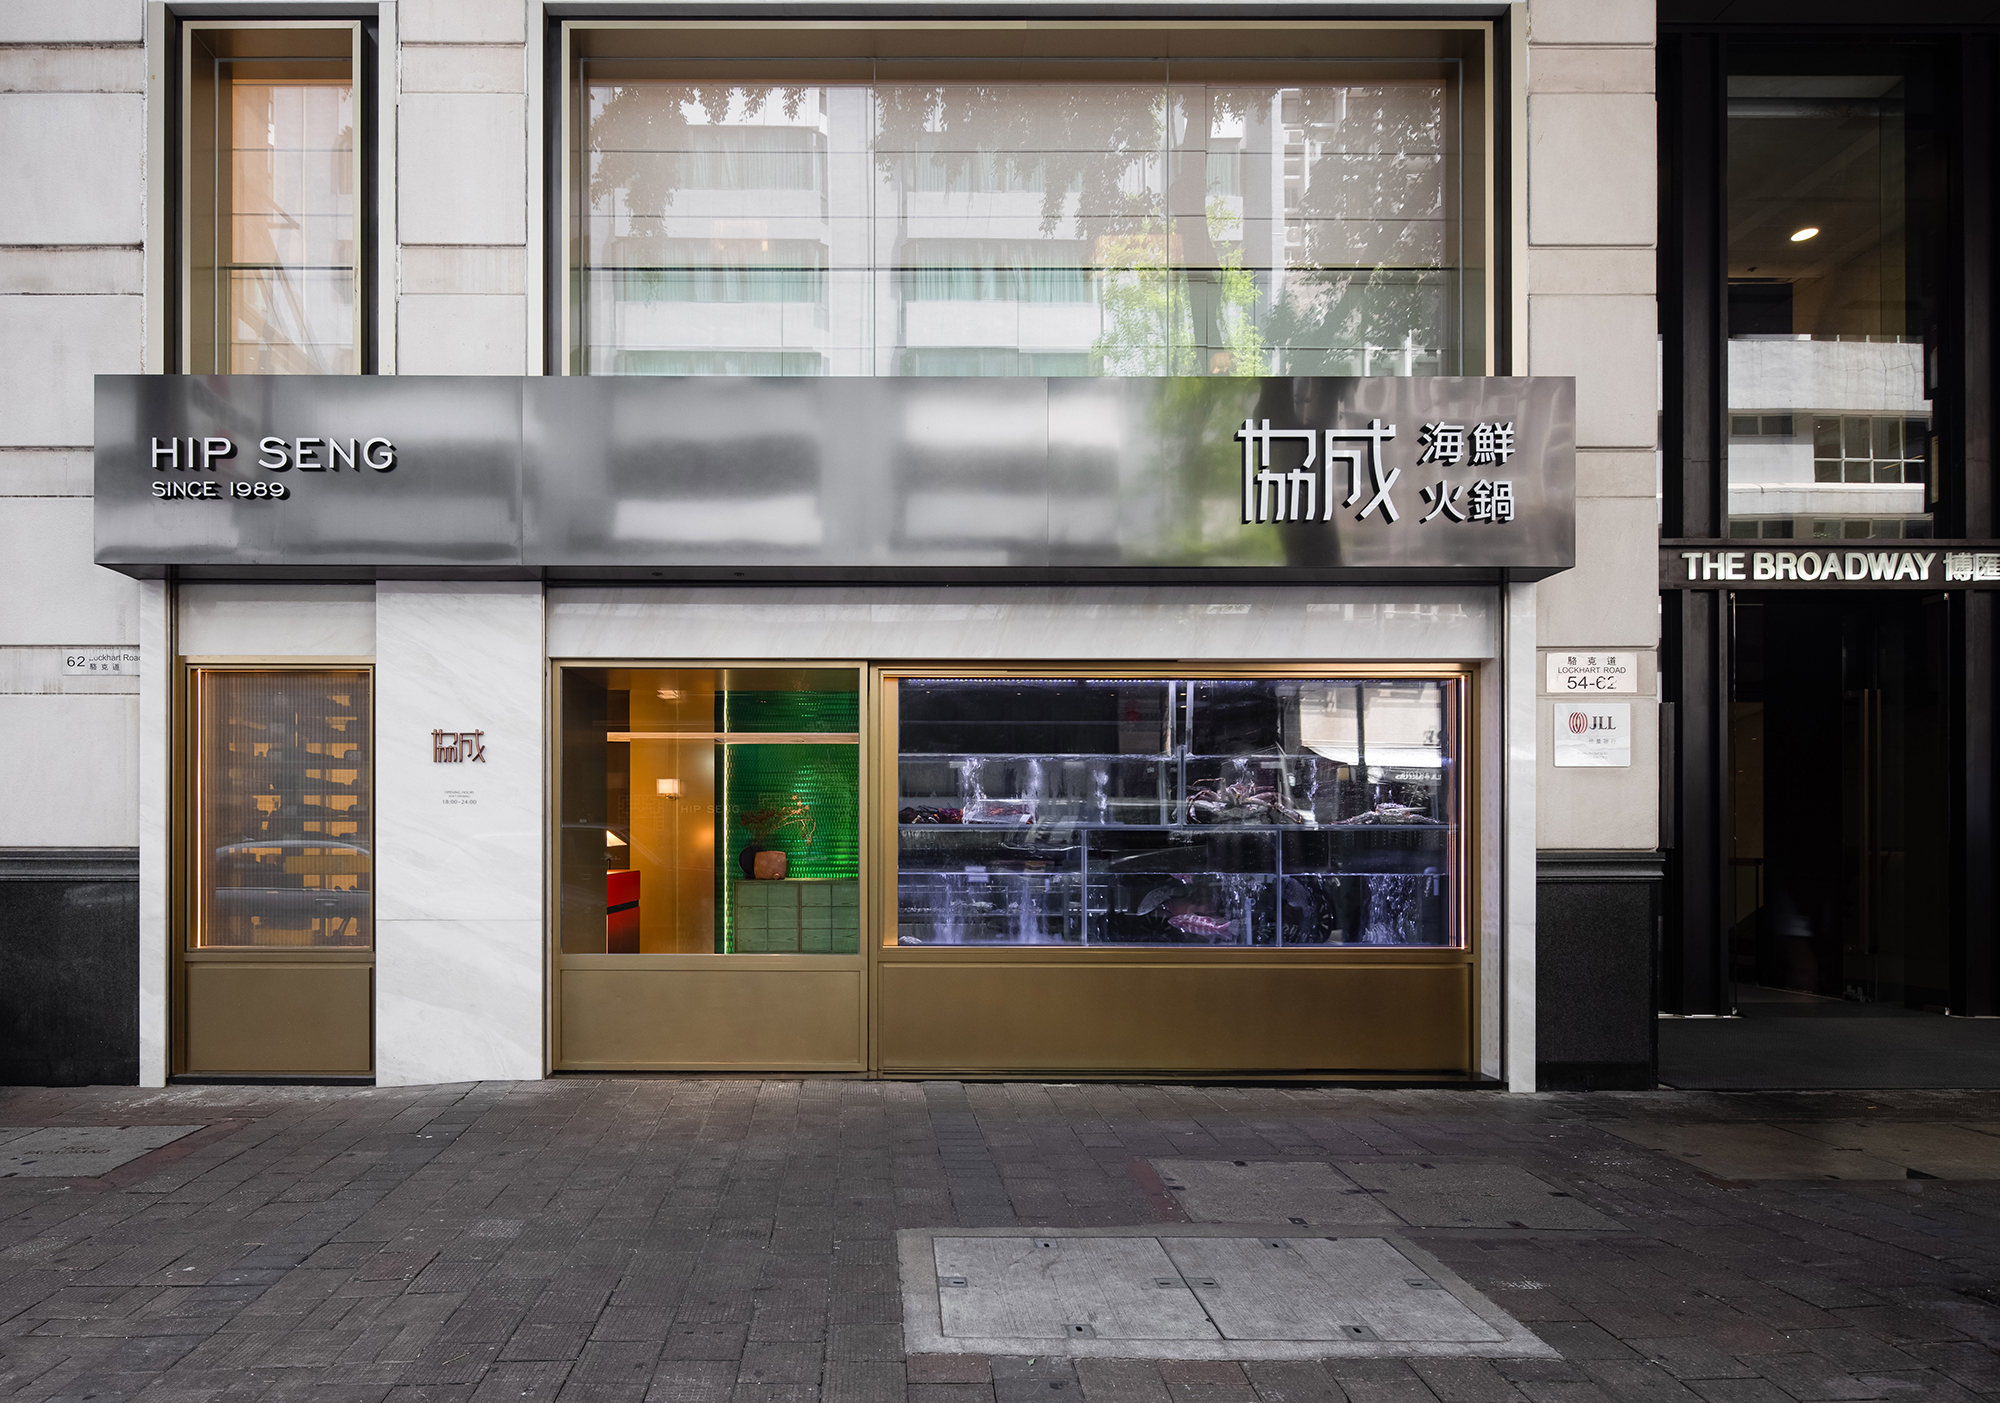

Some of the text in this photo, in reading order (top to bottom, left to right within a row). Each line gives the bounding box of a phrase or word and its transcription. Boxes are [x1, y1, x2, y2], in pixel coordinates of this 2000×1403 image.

[1420, 421, 1516, 464] 海鮮
[151, 436, 396, 470] HIP SENG
[1237, 418, 1402, 523] 協成
[151, 481, 288, 498] SINCE 1989
[1420, 479, 1516, 522] 火鍋
[1681, 551, 2000, 581] THE BROADWAY 博匯
[66, 655, 86, 668] 62
[89, 654, 121, 662] ockhart
[1567, 656, 1617, 666] 駱克道
[1557, 666, 1627, 674] LOCKHART ROAD
[1567, 676, 1618, 690] 54-62
[1589, 715, 1617, 730] JLL
[681, 804, 701, 814] HIP
